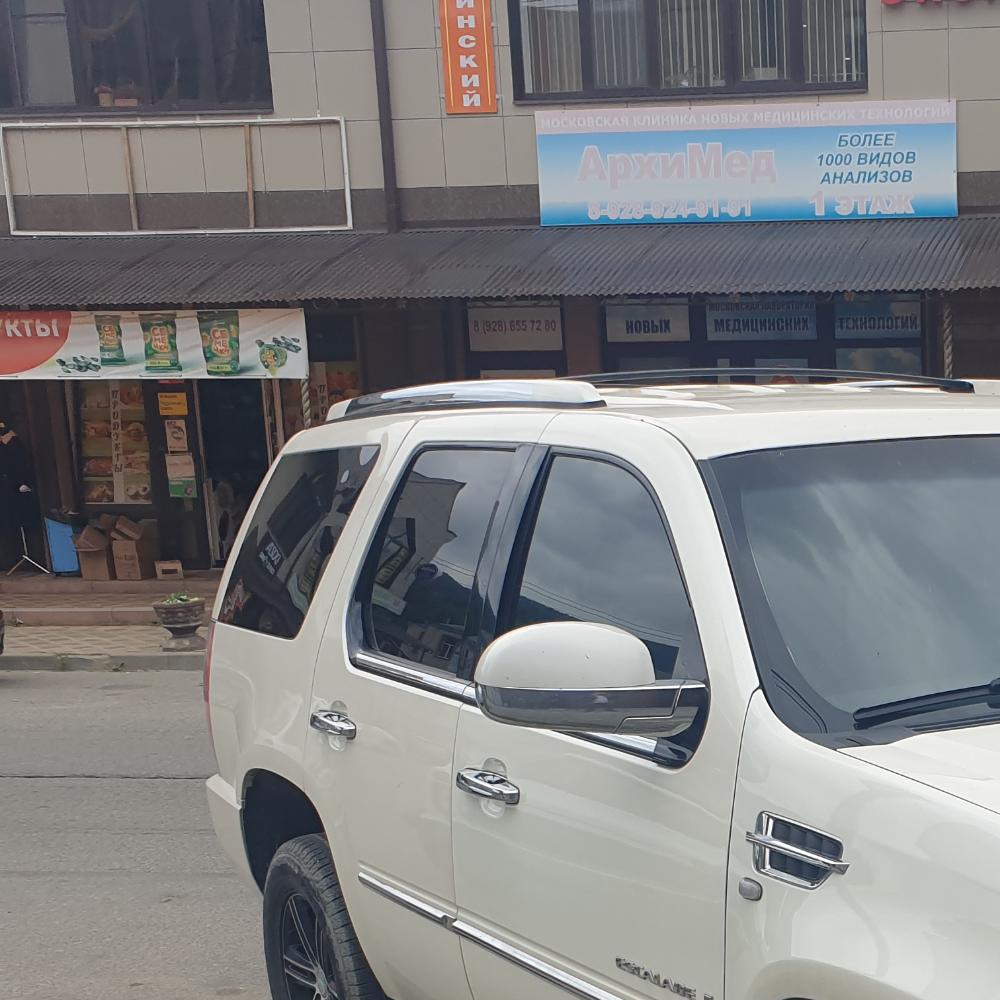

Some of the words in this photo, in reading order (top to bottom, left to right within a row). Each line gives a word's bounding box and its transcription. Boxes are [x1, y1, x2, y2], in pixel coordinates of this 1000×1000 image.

[541, 116, 629, 129] МОСКОВСКАЯ
[633, 112, 697, 127] КЛИНИКА
[702, 110, 749, 124] НОВЫХ
[753, 108, 856, 125] МЕДИЦИНСКИХ
[860, 105, 951, 121] ТЕХНОЛОГИЙ
[838, 133, 896, 149] БОЛЕЕ
[577, 142, 777, 190] АрхиМед
[817, 153, 852, 167] 1000
[857, 151, 917, 168] ВИДОВ
[820, 170, 913, 185] АНАЛИЗОВ
[809, 190, 825, 216] 1
[834, 195, 915, 216] ЭТАЖ
[0, 318, 60, 337] КТЫ
[482, 319, 507, 334] (928)
[509, 319, 527, 332] 655
[530, 319, 542, 331] 72
[625, 319, 671, 334] НОВЫХ
[714, 316, 809, 333] МЕДИЦИНСКИХ
[838, 314, 918, 331] ТЕХНОЛОГИЙ
[111, 390, 123, 473] ПРОДУКТЫ
